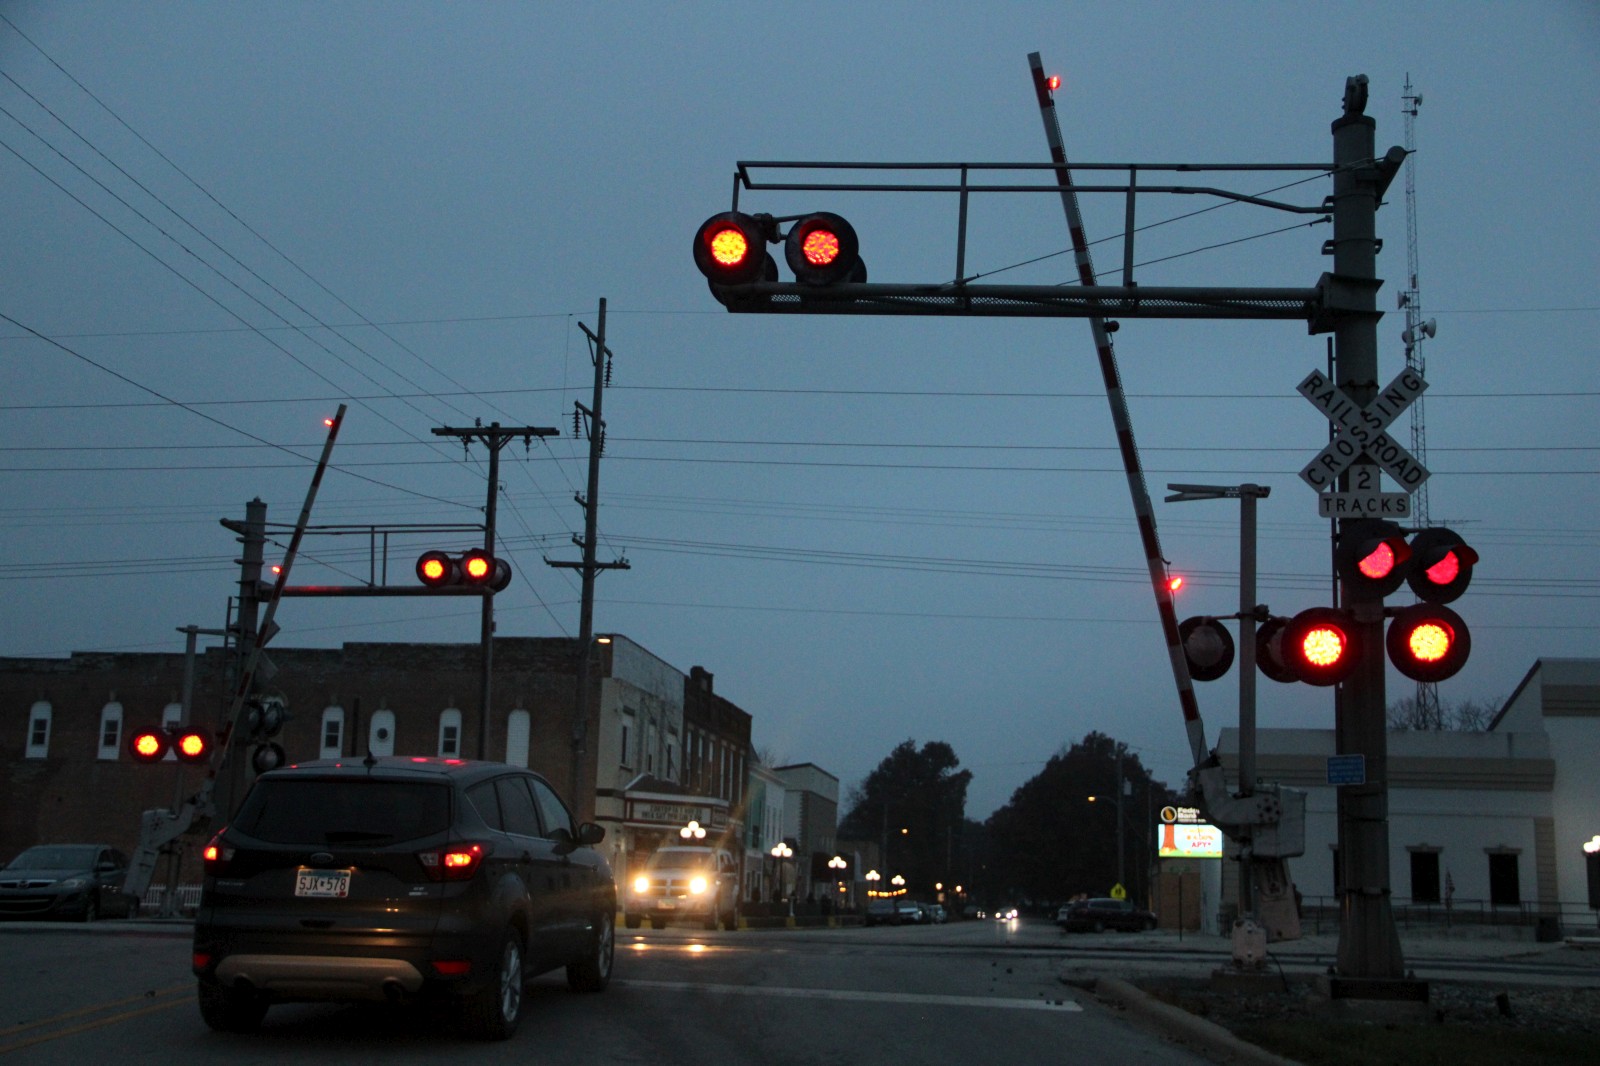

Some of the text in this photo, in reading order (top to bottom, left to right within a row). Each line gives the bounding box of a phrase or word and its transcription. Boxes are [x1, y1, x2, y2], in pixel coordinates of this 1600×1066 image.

[1307, 374, 1421, 486] CROSSING
[1357, 470, 1371, 490] 2
[1323, 498, 1407, 513] TRACKS
